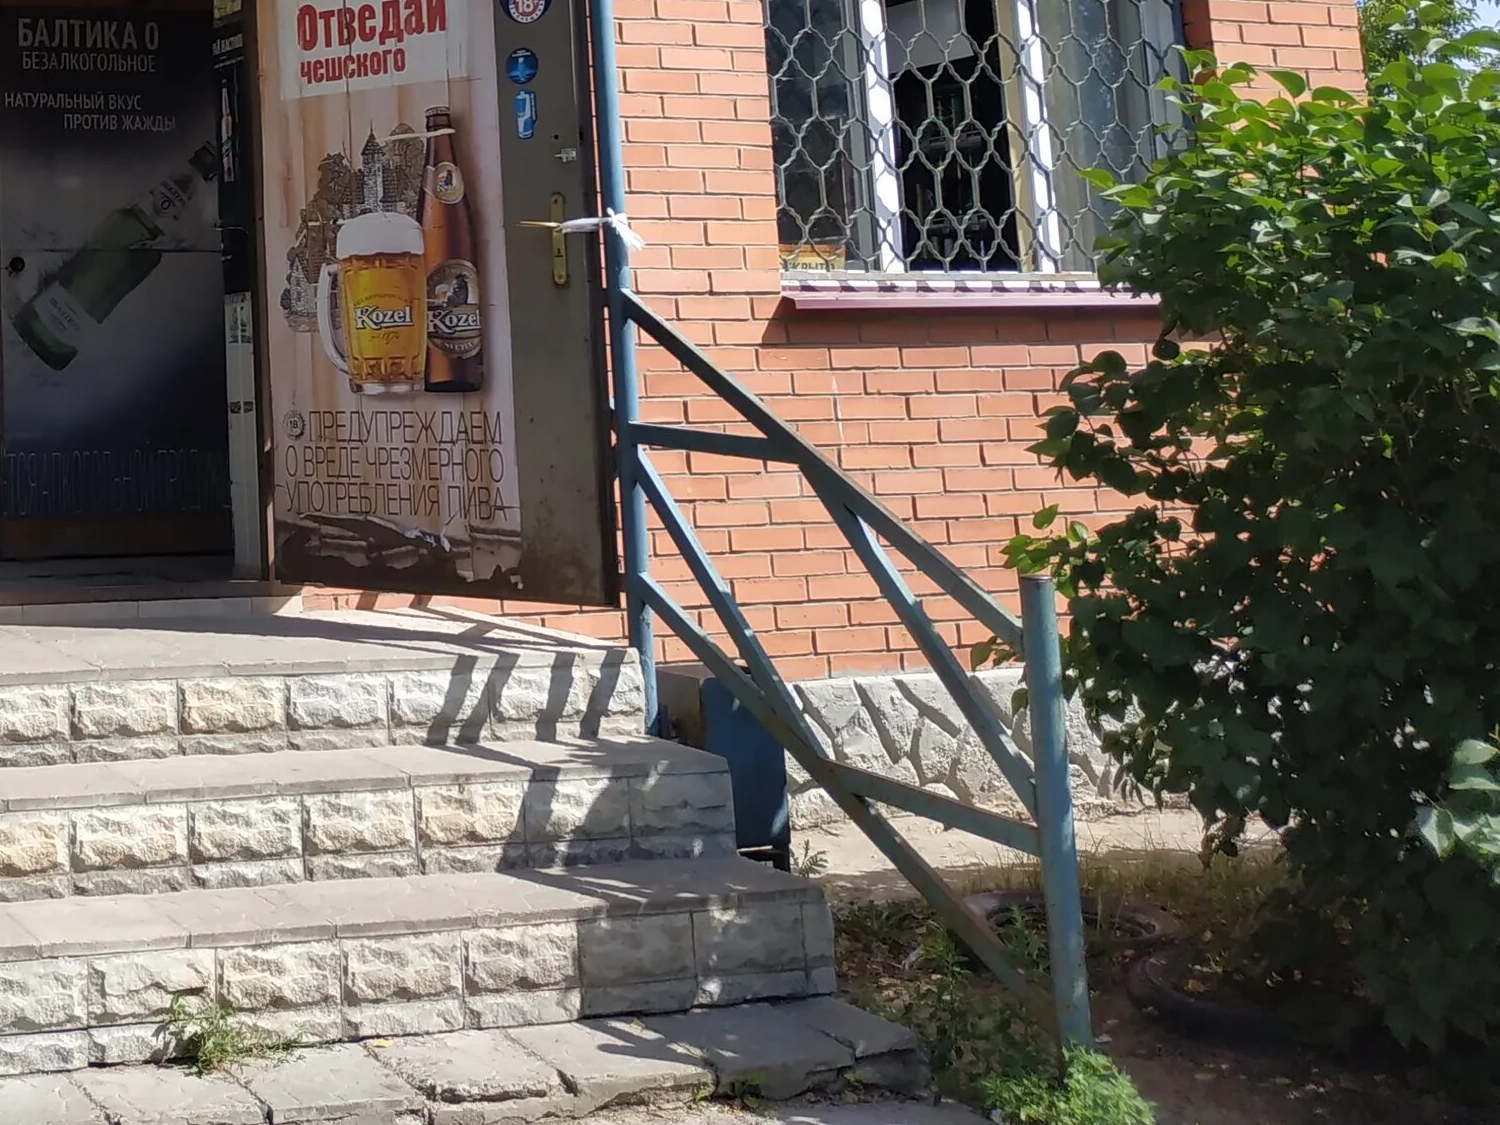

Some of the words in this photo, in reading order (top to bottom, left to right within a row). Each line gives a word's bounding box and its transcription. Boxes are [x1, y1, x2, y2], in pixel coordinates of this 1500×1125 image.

[18, 18, 138, 50] БАЛТИКА
[22, 51, 156, 72] БЕЗАЛКОГОЛЬНОЕ
[300, 48, 405, 84] чешского
[4, 91, 104, 110] НАТУРАЛЬНЫЙ
[108, 94, 142, 110] ВКУС
[64, 114, 117, 130] ПРОТИВ
[122, 115, 175, 132] ЖАЖДЫ
[356, 306, 412, 329] Kozel
[428, 309, 481, 333] Kozel
[309, 411, 503, 446] ПРЕДУПРЕЖДАЕМ
[285, 445, 298, 477] О
[303, 446, 361, 480] ВРЕДЕ
[365, 447, 505, 483] ЧРЕЗМЕРНОГО
[286, 481, 440, 517] УПОТРЕБЛЕНИЯ
[448, 486, 508, 521] ПИВА
